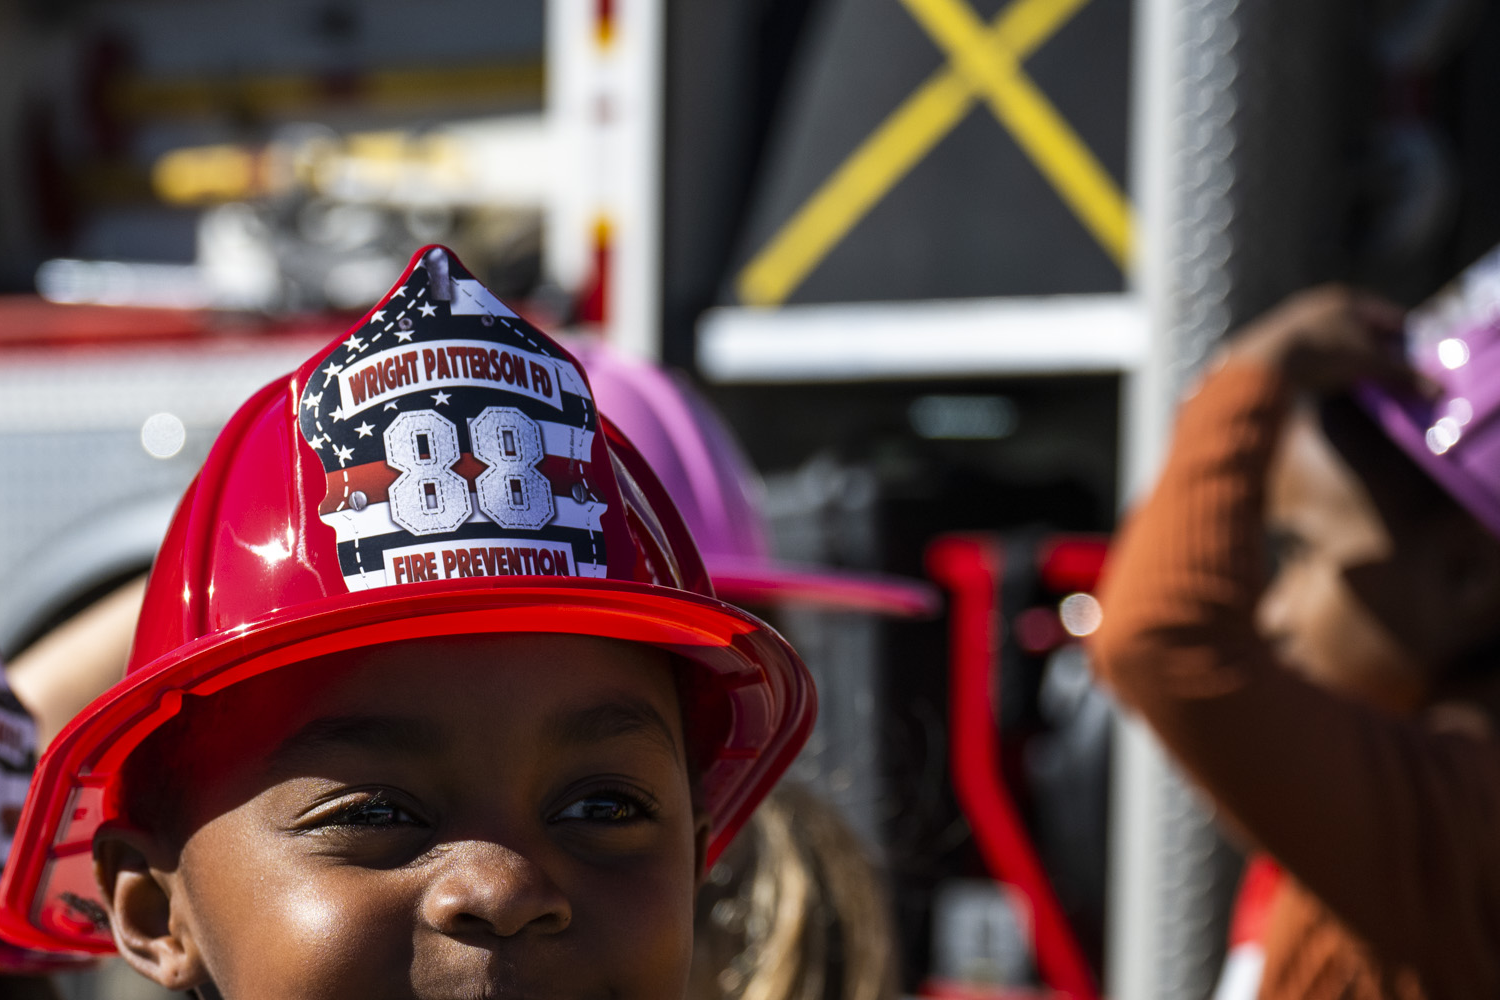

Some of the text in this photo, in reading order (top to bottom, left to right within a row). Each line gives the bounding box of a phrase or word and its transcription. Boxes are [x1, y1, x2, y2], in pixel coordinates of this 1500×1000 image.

[348, 346, 553, 407] WRIGHT PATTERSON FD
[383, 406, 555, 537] 88
[392, 546, 570, 585] FIRE PREVENTION
